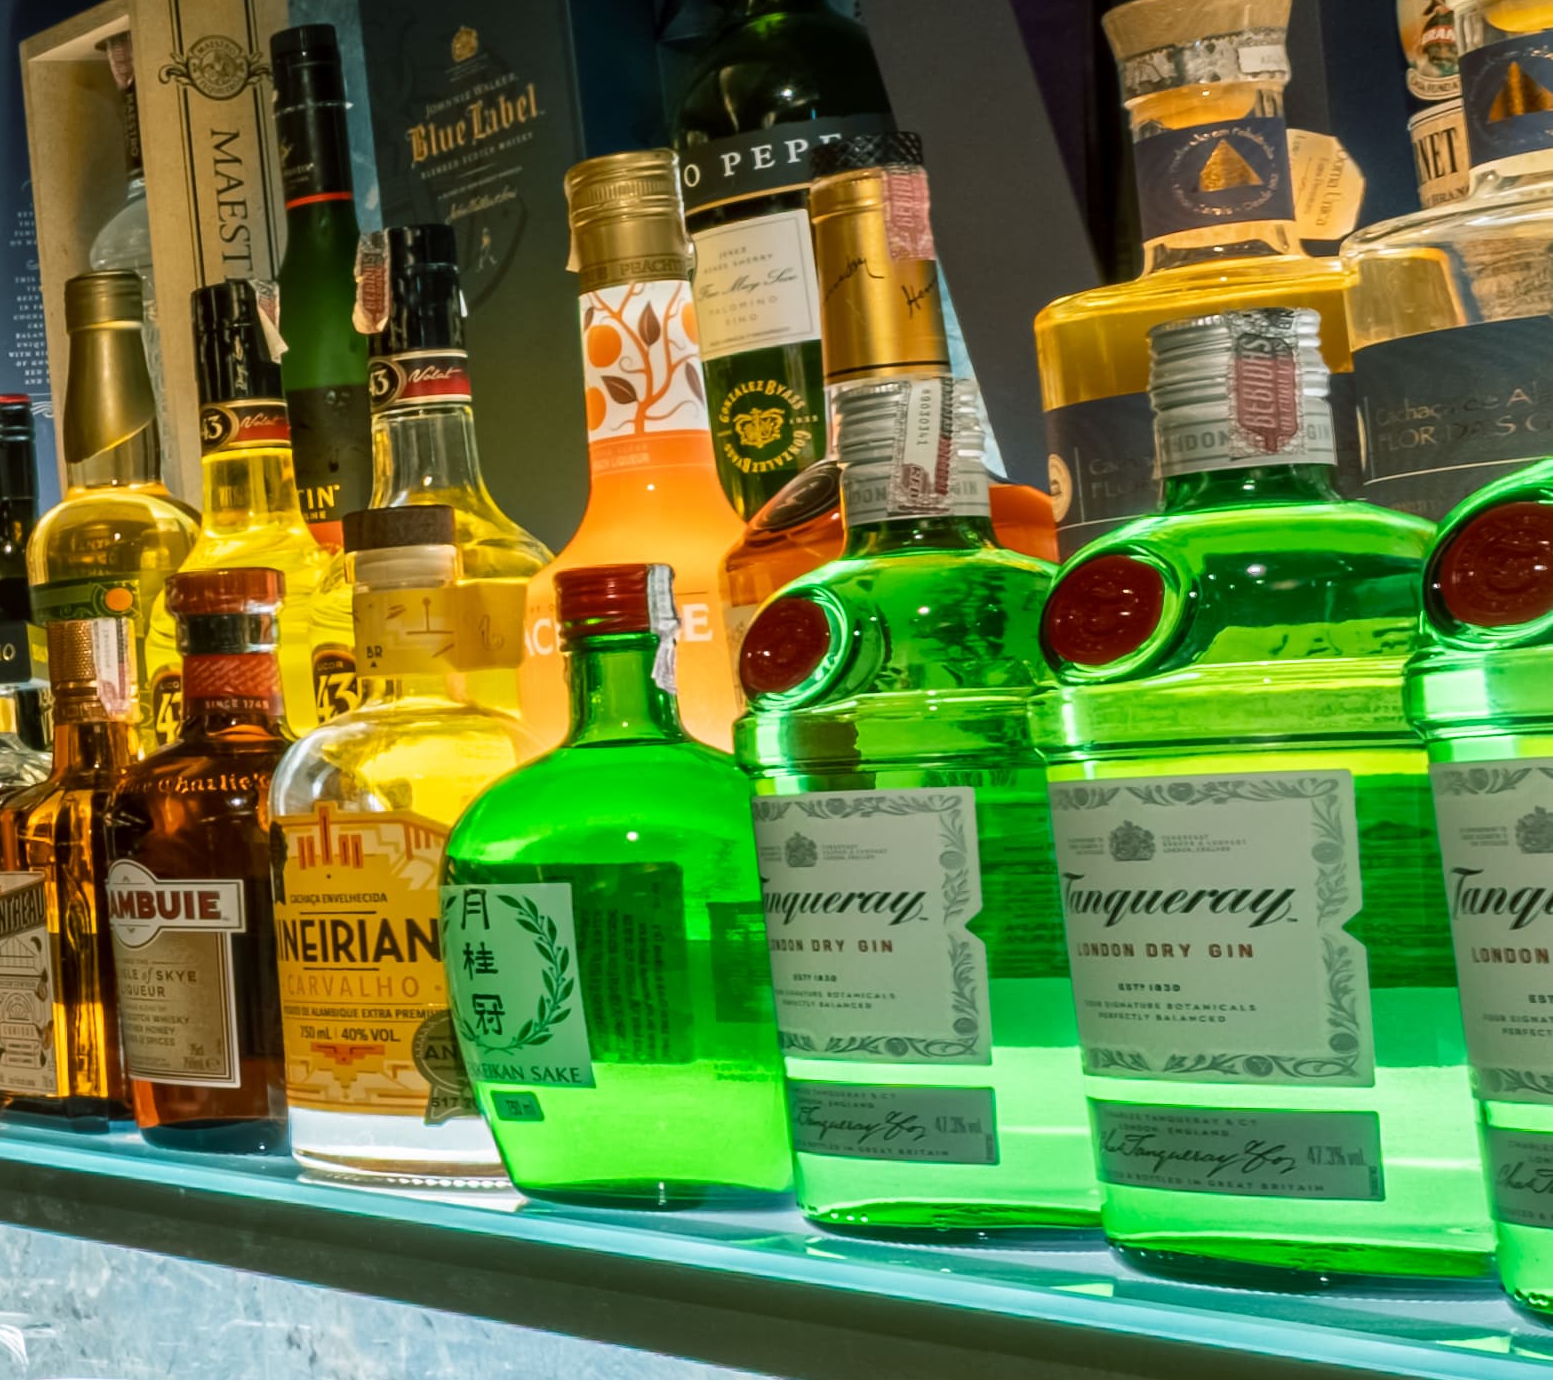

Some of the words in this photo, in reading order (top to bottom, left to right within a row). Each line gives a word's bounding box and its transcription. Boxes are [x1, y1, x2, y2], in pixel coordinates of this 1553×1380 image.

[407, 120, 467, 168] Blue
[466, 83, 539, 143] Label
[210, 128, 255, 281] MAEST
[366, 646, 382, 659] BR
[1062, 873, 1296, 928] Tanqueray
[812, 939, 845, 952] DRY
[858, 939, 893, 953] GIN
[1077, 942, 1135, 957] LONDON
[1146, 943, 1191, 958] DRY
[1208, 943, 1254, 958] GIN
[461, 888, 505, 1035] 月桂冠
[1471, 947, 1550, 964] LONDON
[156, 970, 197, 982] SKYE
[287, 975, 420, 998] CARVALHO
[1149, 983, 1182, 993] 1830
[361, 1007, 393, 1019] EXTRA
[1166, 1002, 1257, 1012] BOTANICALS
[1155, 1013, 1227, 1023] BALANCED
[341, 1028, 368, 1041] 40%
[531, 1065, 583, 1084] SAKE
